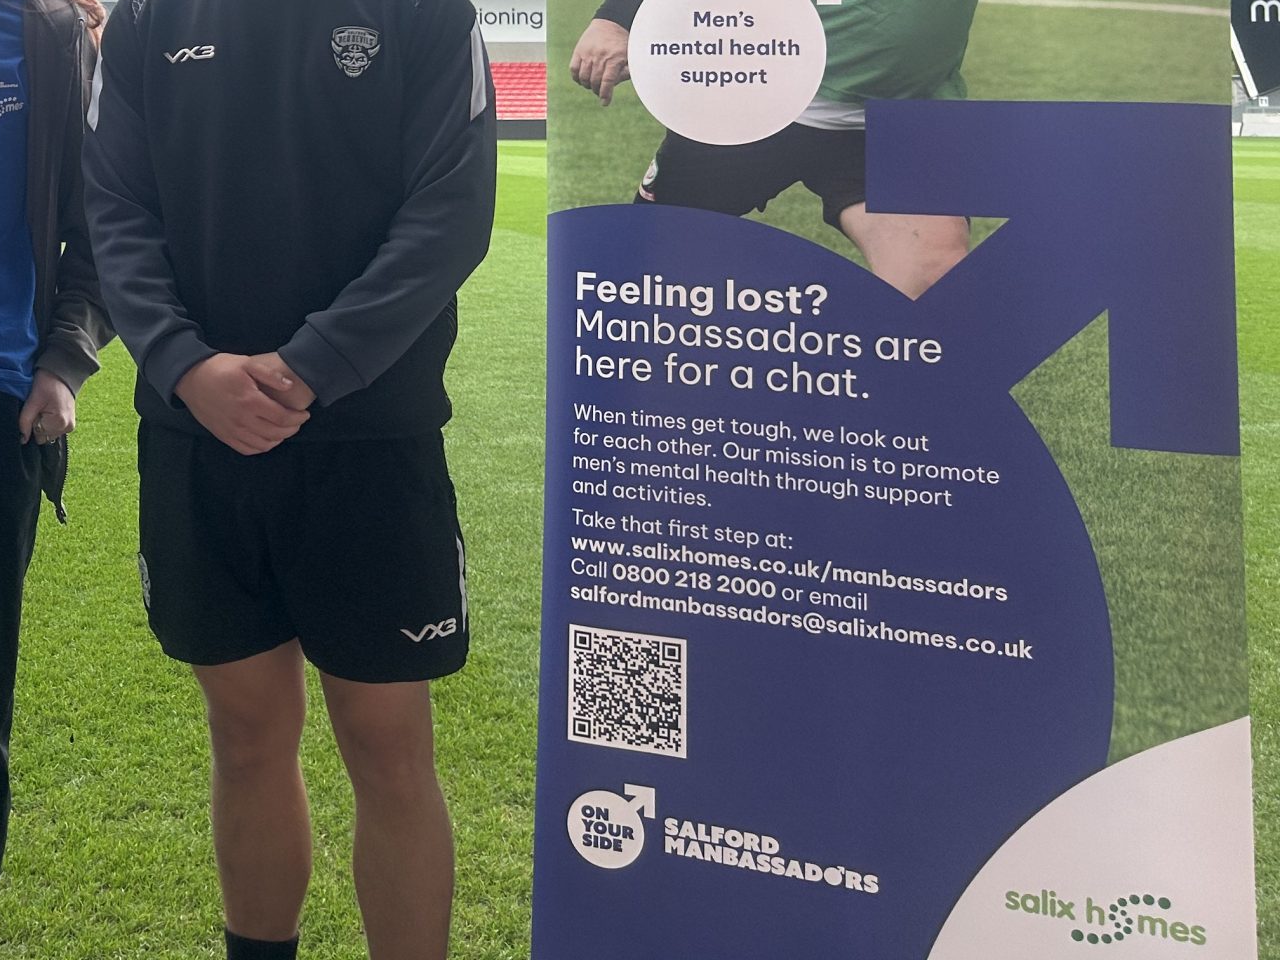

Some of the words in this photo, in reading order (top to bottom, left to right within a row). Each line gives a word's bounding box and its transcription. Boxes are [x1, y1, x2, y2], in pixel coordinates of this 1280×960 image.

[476, 7, 543, 29] ioning
[693, 11, 755, 28] Men's
[163, 45, 215, 64] VX3
[650, 38, 723, 56] mental
[730, 38, 800, 56] health
[680, 69, 768, 87] support
[577, 271, 713, 316] Feeling
[726, 279, 828, 316] lost?
[576, 309, 862, 358] Manbassadors
[875, 336, 942, 363] are
[576, 345, 652, 381] here
[664, 353, 719, 386] for
[730, 366, 753, 389] a
[766, 361, 869, 399] chat.
[574, 403, 626, 425] When
[630, 409, 686, 430] times
[691, 417, 725, 435] get
[730, 418, 797, 442] tough,
[802, 427, 834, 443] we
[840, 426, 886, 448] look
[892, 435, 930, 452] out
[573, 427, 599, 446] for
[603, 434, 652, 452] each
[657, 437, 717, 457] other.
[723, 442, 760, 461] Our
[766, 447, 845, 470] mission
[851, 453, 867, 472] is
[872, 457, 896, 474] to
[902, 463, 1000, 484] promote
[572, 479, 607, 496] and
[612, 484, 712, 507] activities.
[573, 456, 626, 474] men's
[631, 462, 699, 481] mental
[705, 464, 770, 488] health
[775, 472, 858, 500] through
[864, 485, 953, 507] support
[571, 508, 616, 530] Take
[620, 515, 663, 535] that
[668, 519, 709, 540] first
[714, 526, 760, 548] step
[765, 533, 793, 550] at:
[571, 536, 1008, 602] www.salixhomes.co.uk/manbassadors
[571, 558, 607, 578] Call
[612, 563, 670, 585] 0800
[675, 570, 711, 590] 218
[717, 575, 776, 598] 2000
[781, 588, 804, 602] or
[809, 591, 867, 611] email
[400, 617, 457, 643] VX3
[570, 585, 1033, 660] salfordmanbassadors@salixhomes.co.uk
[581, 805, 609, 821] ON
[581, 818, 634, 840] YOUR
[582, 834, 623, 852] SIDE
[664, 818, 780, 855] SALFORD
[664, 836, 879, 894] MANBASSADORS
[1005, 889, 1076, 920] salix
[1086, 896, 1207, 946] homes
